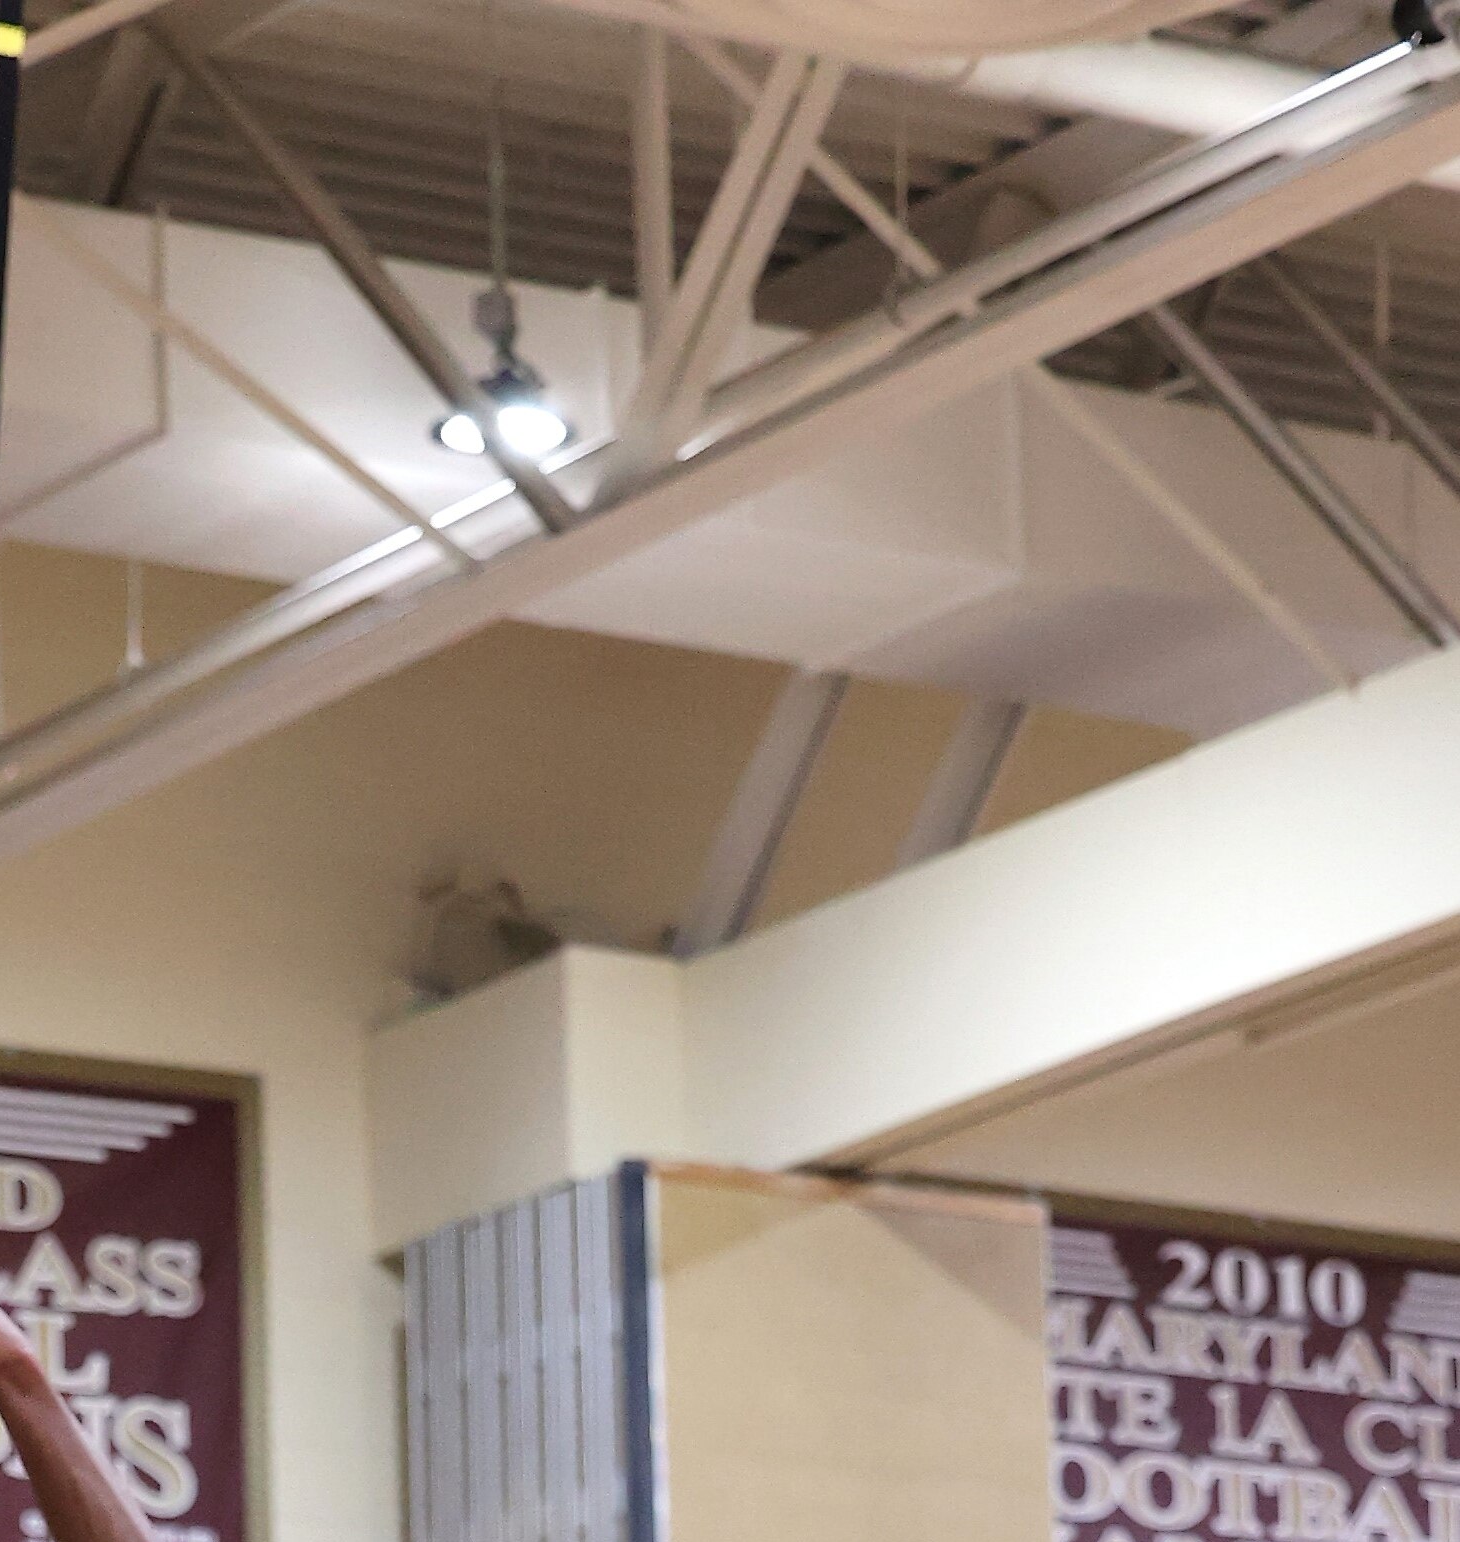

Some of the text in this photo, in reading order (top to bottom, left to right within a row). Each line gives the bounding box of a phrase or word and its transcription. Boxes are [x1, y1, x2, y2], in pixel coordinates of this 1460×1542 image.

[1157, 1240, 1367, 1328] 2010
[1051, 1366, 1183, 1451] TE
[1344, 1400, 1460, 1484] CL
